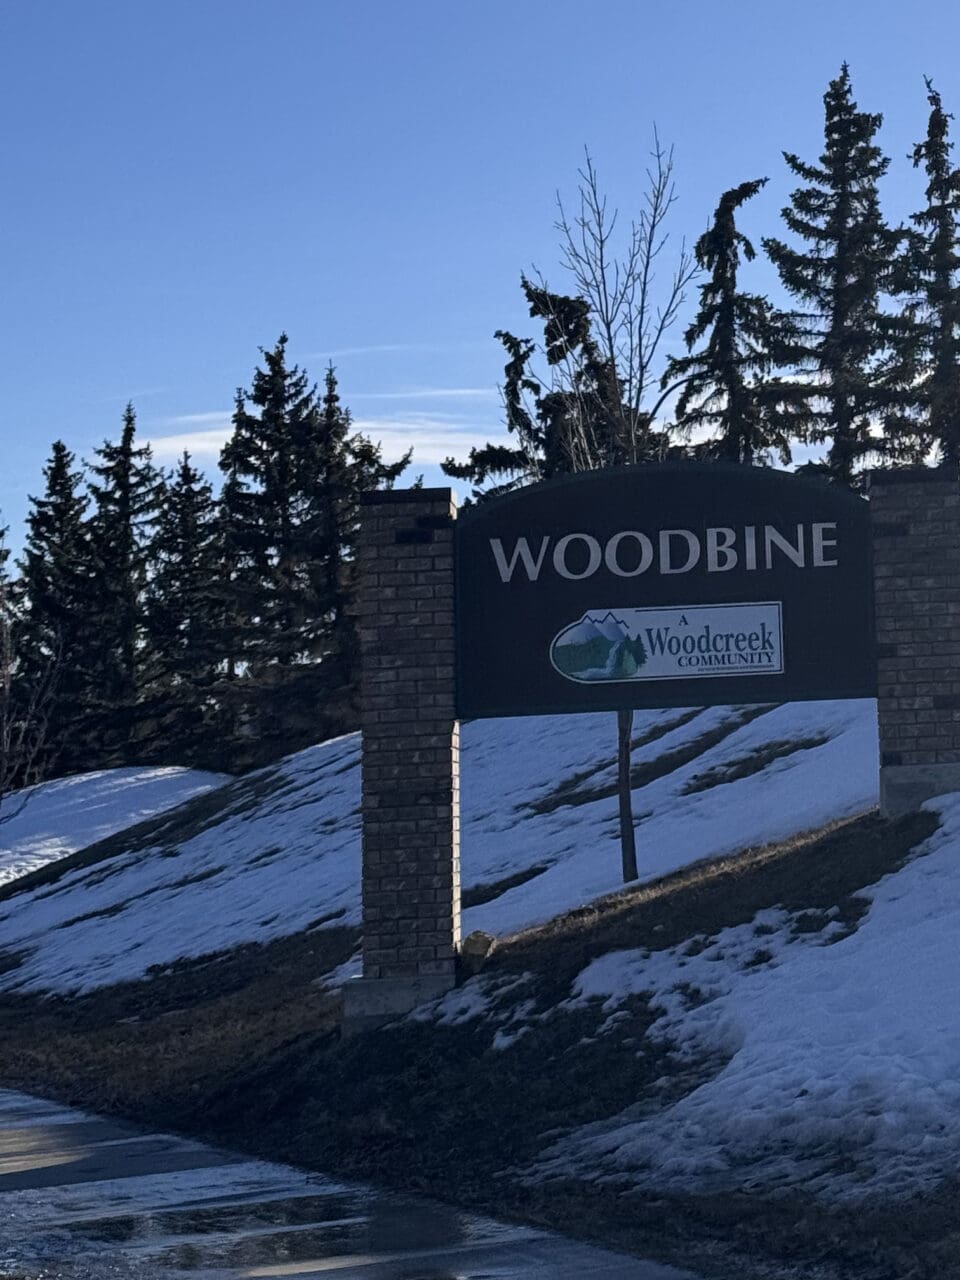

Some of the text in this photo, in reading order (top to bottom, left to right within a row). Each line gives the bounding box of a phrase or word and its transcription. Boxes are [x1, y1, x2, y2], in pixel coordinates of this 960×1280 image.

[489, 522, 838, 582] WOODBINE
[678, 614, 689, 626] A
[645, 622, 774, 656] Woodcreek
[677, 651, 775, 668] COMMUNITY
